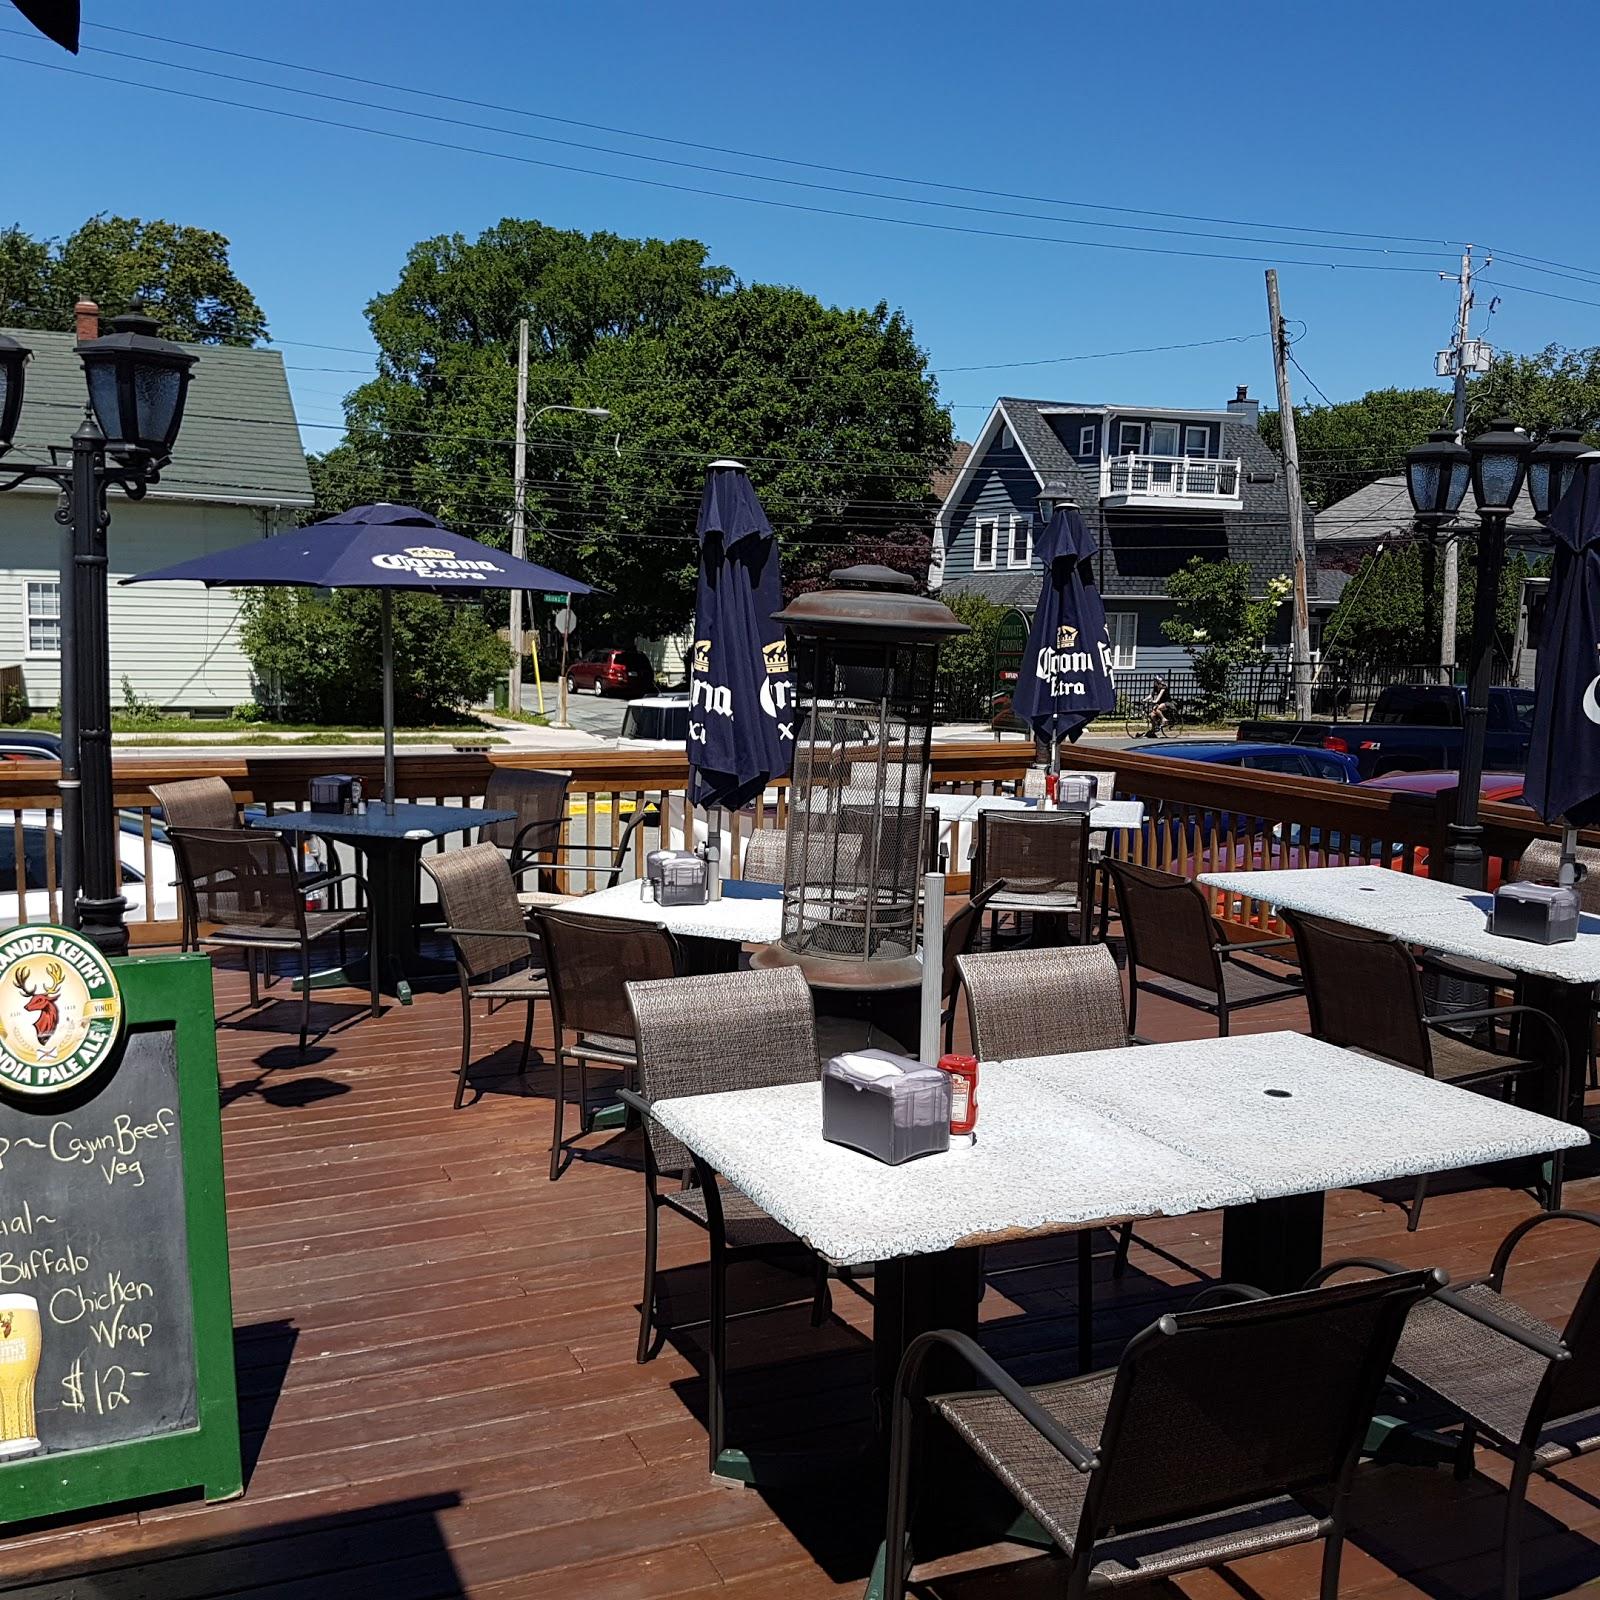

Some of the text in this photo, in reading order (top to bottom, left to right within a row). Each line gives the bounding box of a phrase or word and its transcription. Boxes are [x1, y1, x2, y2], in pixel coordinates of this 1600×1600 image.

[371, 554, 506, 573] Corona
[414, 567, 487, 580] Extra
[1050, 676, 1086, 697] Etra
[57, 939, 106, 989] KEITH'S
[37, 1057, 84, 1085] PALE
[79, 1030, 111, 1065] ALE
[50, 1121, 115, 1164] Cajun
[114, 1108, 175, 1155] Beef
[101, 1156, 145, 1187] Veg
[0, 1244, 89, 1285] Buffalo
[89, 1304, 153, 1349] Wrap
